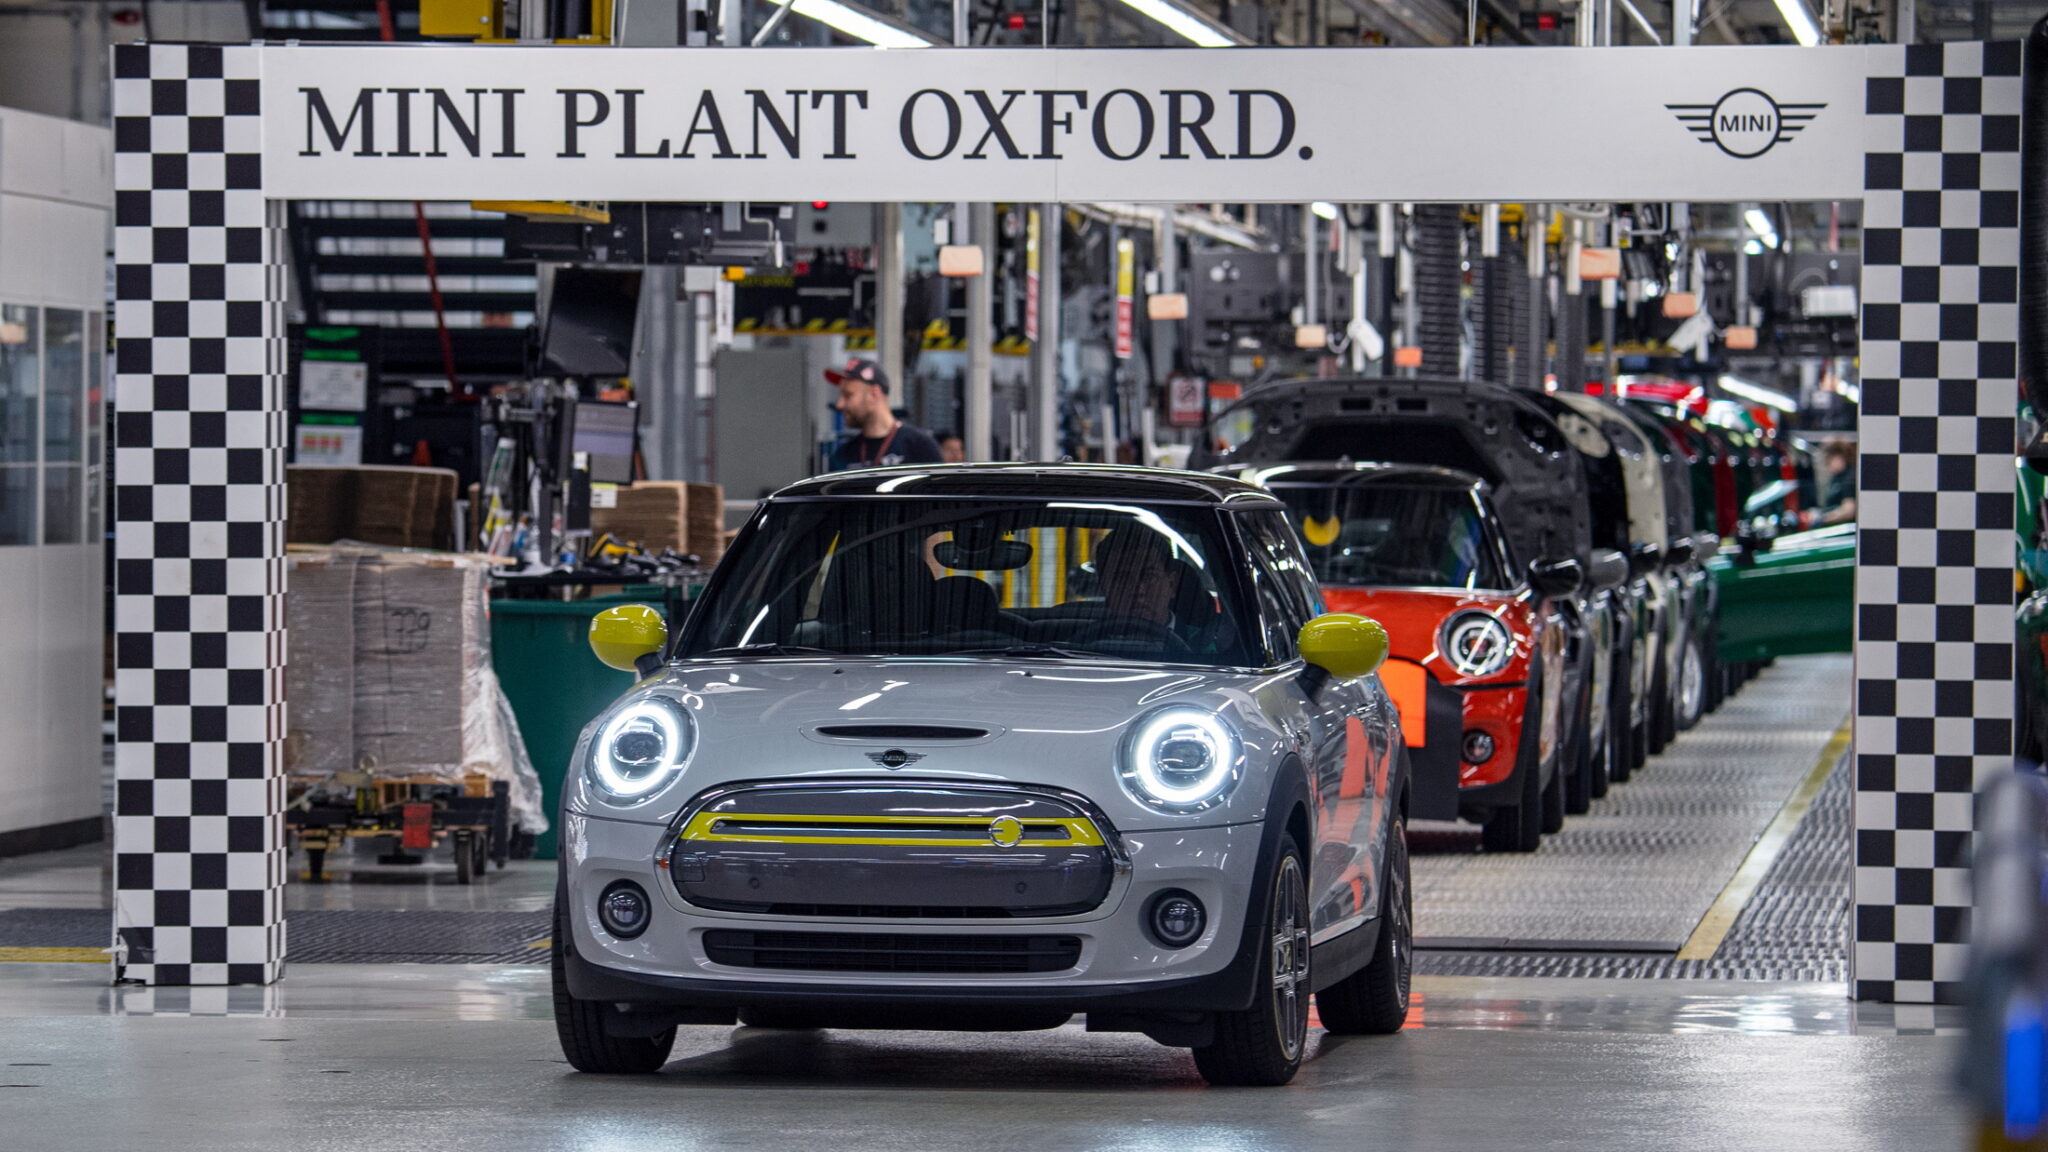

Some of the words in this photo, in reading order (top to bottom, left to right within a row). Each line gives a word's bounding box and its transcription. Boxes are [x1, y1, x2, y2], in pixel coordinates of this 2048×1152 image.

[299, 88, 525, 158] MINI
[557, 89, 868, 159] PLANT
[899, 89, 1314, 161] OXFORD.
[1720, 115, 1772, 132] MINI
